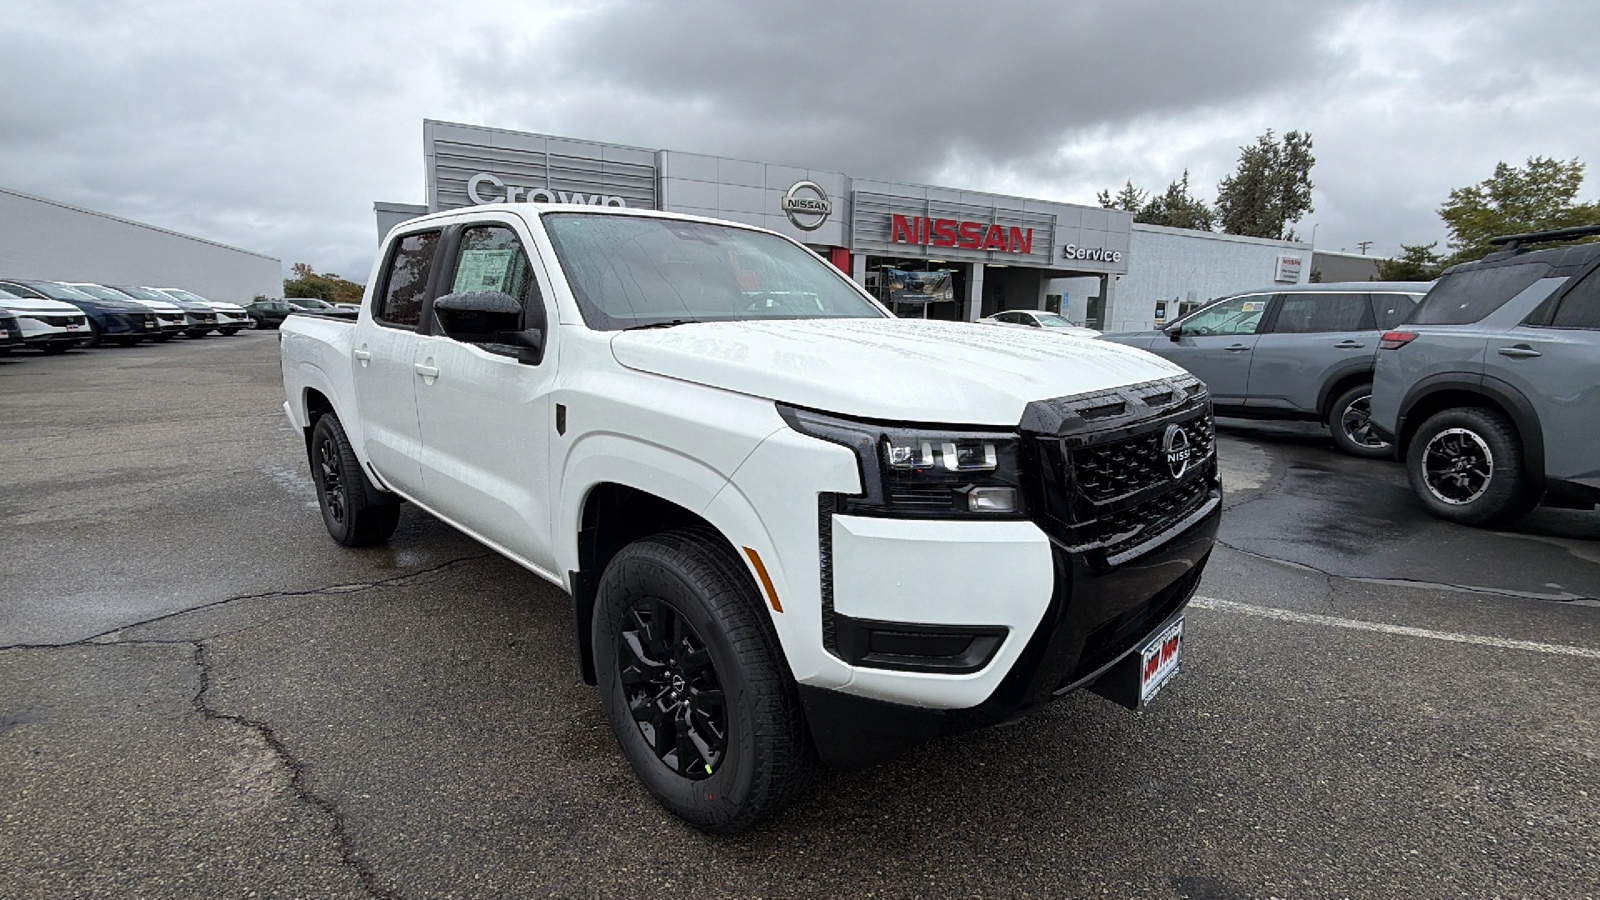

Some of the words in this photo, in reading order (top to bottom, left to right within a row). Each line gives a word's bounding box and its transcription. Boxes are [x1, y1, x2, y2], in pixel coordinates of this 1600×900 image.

[467, 173, 627, 207] Crown
[788, 199, 828, 211] NISSAN
[891, 213, 1033, 254] NISSAN
[1065, 243, 1122, 263] Service
[1167, 449, 1190, 463] NISS
